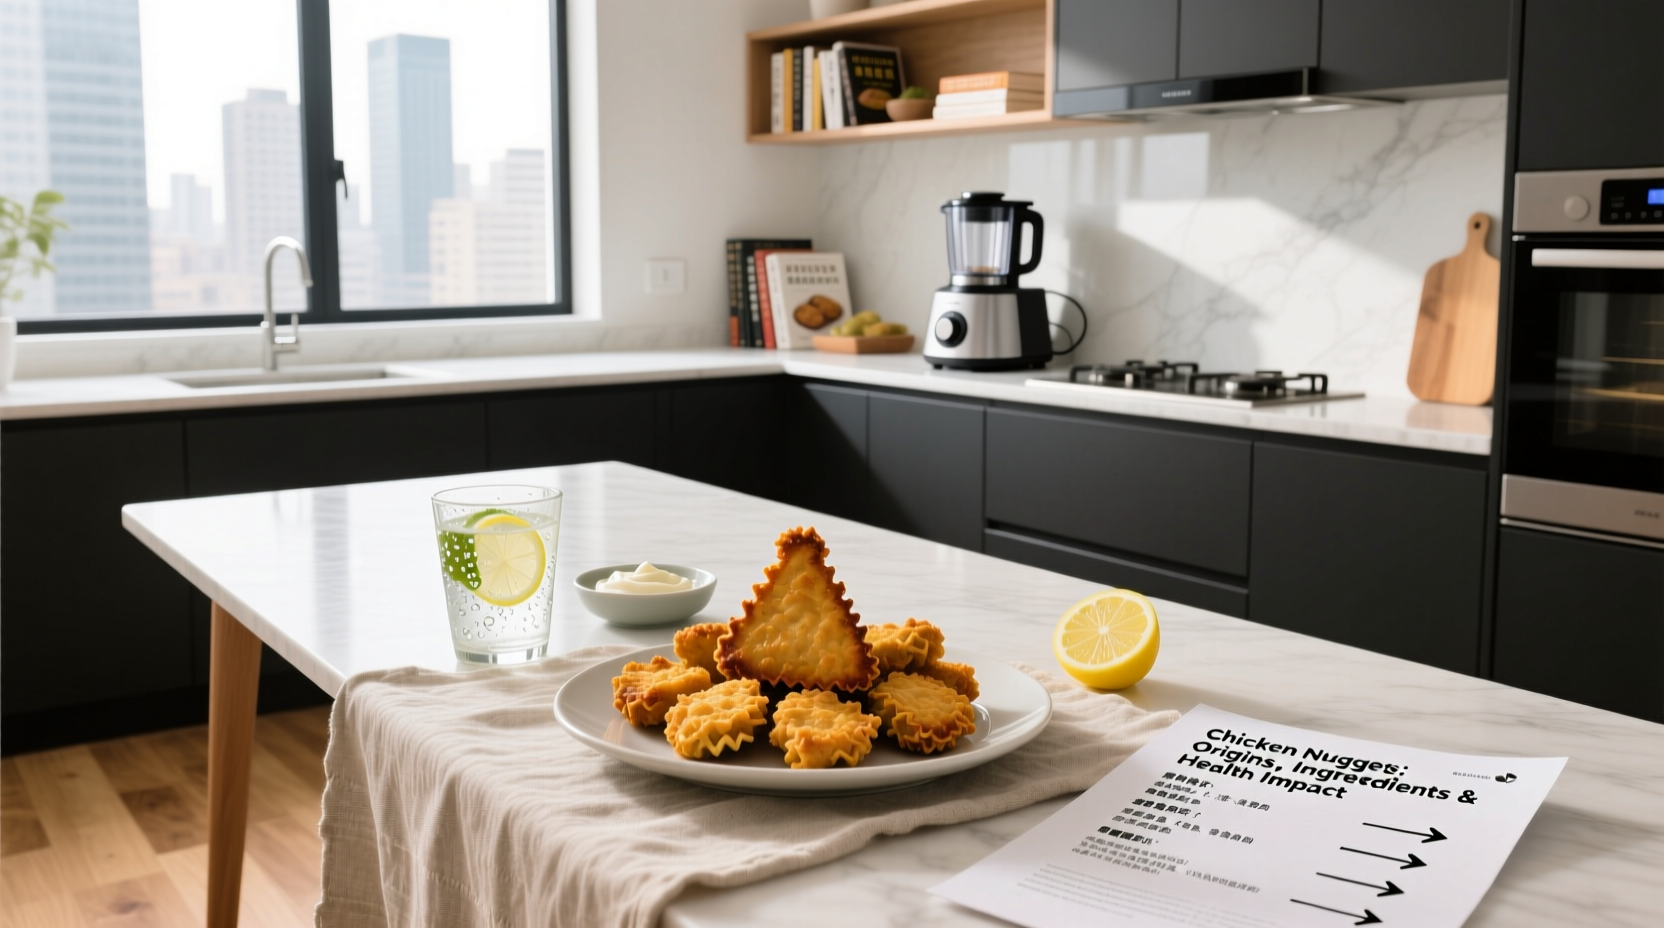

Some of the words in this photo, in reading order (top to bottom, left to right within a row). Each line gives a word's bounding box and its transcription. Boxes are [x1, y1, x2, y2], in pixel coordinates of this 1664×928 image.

[1206, 728, 1298, 757] Chicken
[1177, 753, 1254, 781] Health
[1259, 771, 1348, 799] Impact
[1192, 741, 1283, 772] Origins,
[1457, 789, 1478, 805] &
